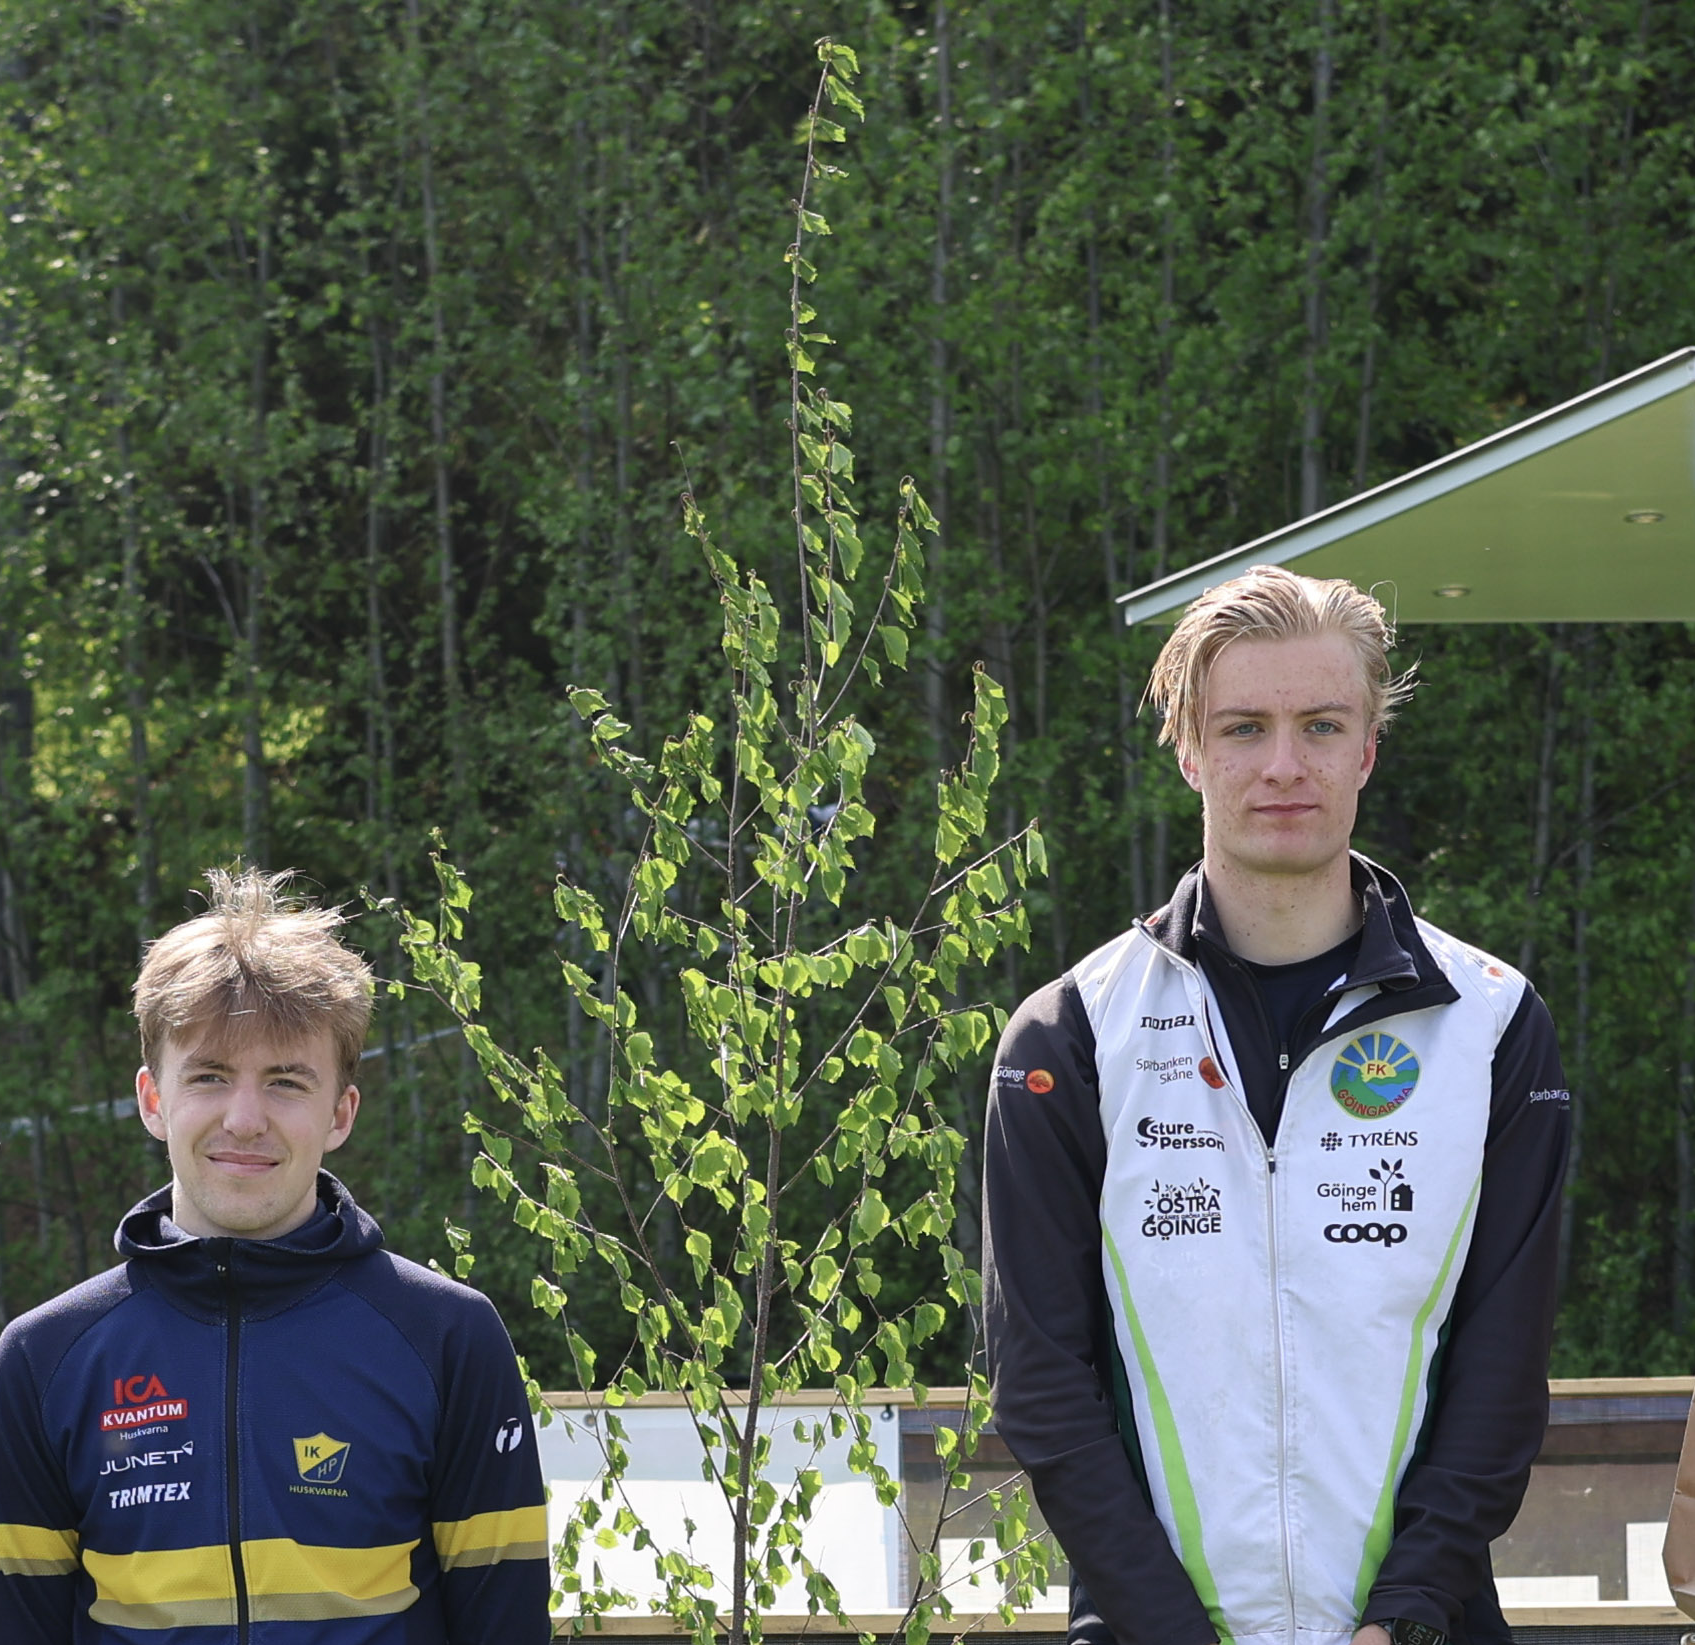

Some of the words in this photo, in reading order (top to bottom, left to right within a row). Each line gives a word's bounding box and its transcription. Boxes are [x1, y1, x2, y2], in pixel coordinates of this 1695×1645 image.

[1160, 1069, 1193, 1085] Skåne
[1367, 1063, 1387, 1076] FK
[1337, 1087, 1413, 1117] GÖINGARNA
[1160, 1137, 1225, 1152] Persson
[1348, 1129, 1418, 1147] TYRÉNS
[1317, 1183, 1377, 1201] Göinge
[1157, 1193, 1221, 1214] ÖSTRA
[1342, 1198, 1376, 1212] hem
[1323, 1222, 1408, 1248] coop
[113, 1373, 168, 1405] ICA
[103, 1403, 183, 1427] KVANTUM
[120, 1425, 169, 1440] Huskvarna
[304, 1446, 321, 1459] IK
[100, 1449, 184, 1475] JUNET
[317, 1457, 338, 1479] HP
[109, 1482, 191, 1509] TRIMTEX
[289, 1485, 348, 1497] HUSKVARNA
